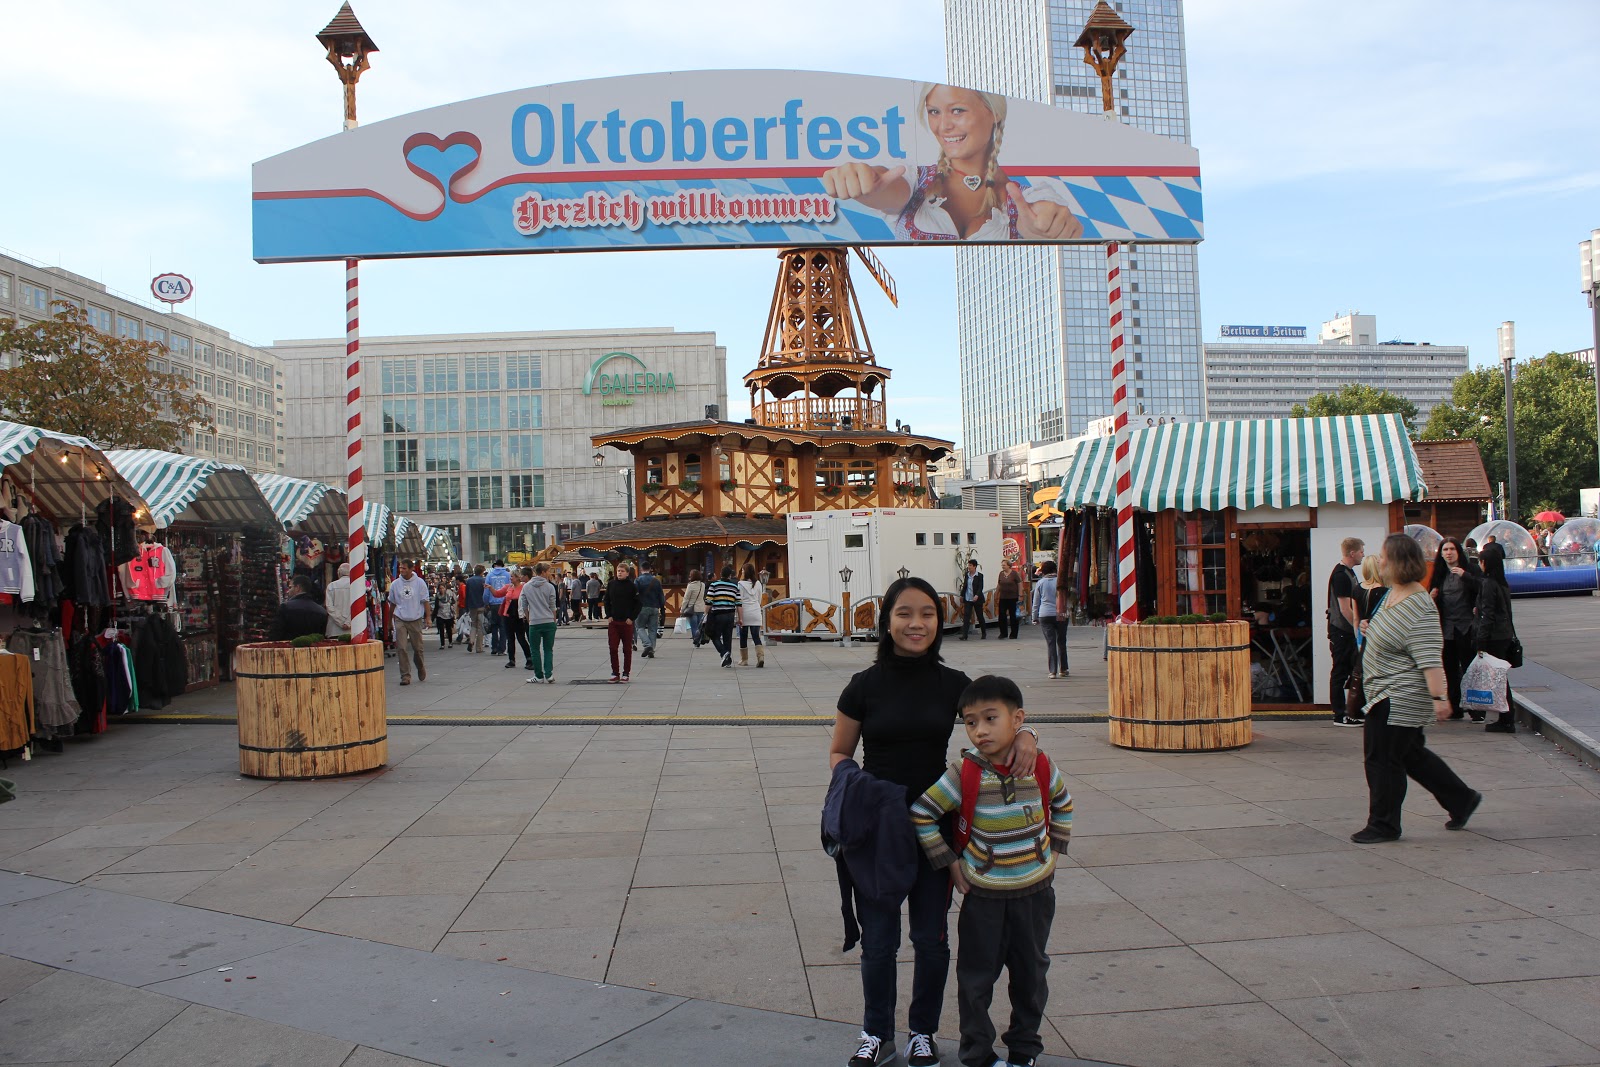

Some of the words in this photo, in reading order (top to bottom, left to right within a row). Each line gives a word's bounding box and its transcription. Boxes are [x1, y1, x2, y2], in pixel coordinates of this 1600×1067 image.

[511, 97, 907, 166] Oktoberfest
[516, 196, 641, 230] Herzlich
[651, 193, 831, 220] willkommen
[157, 280, 186, 295] C&A
[1222, 325, 1260, 336] Berliner
[1273, 326, 1306, 337] Zeitung
[599, 372, 677, 395] GALERIA
